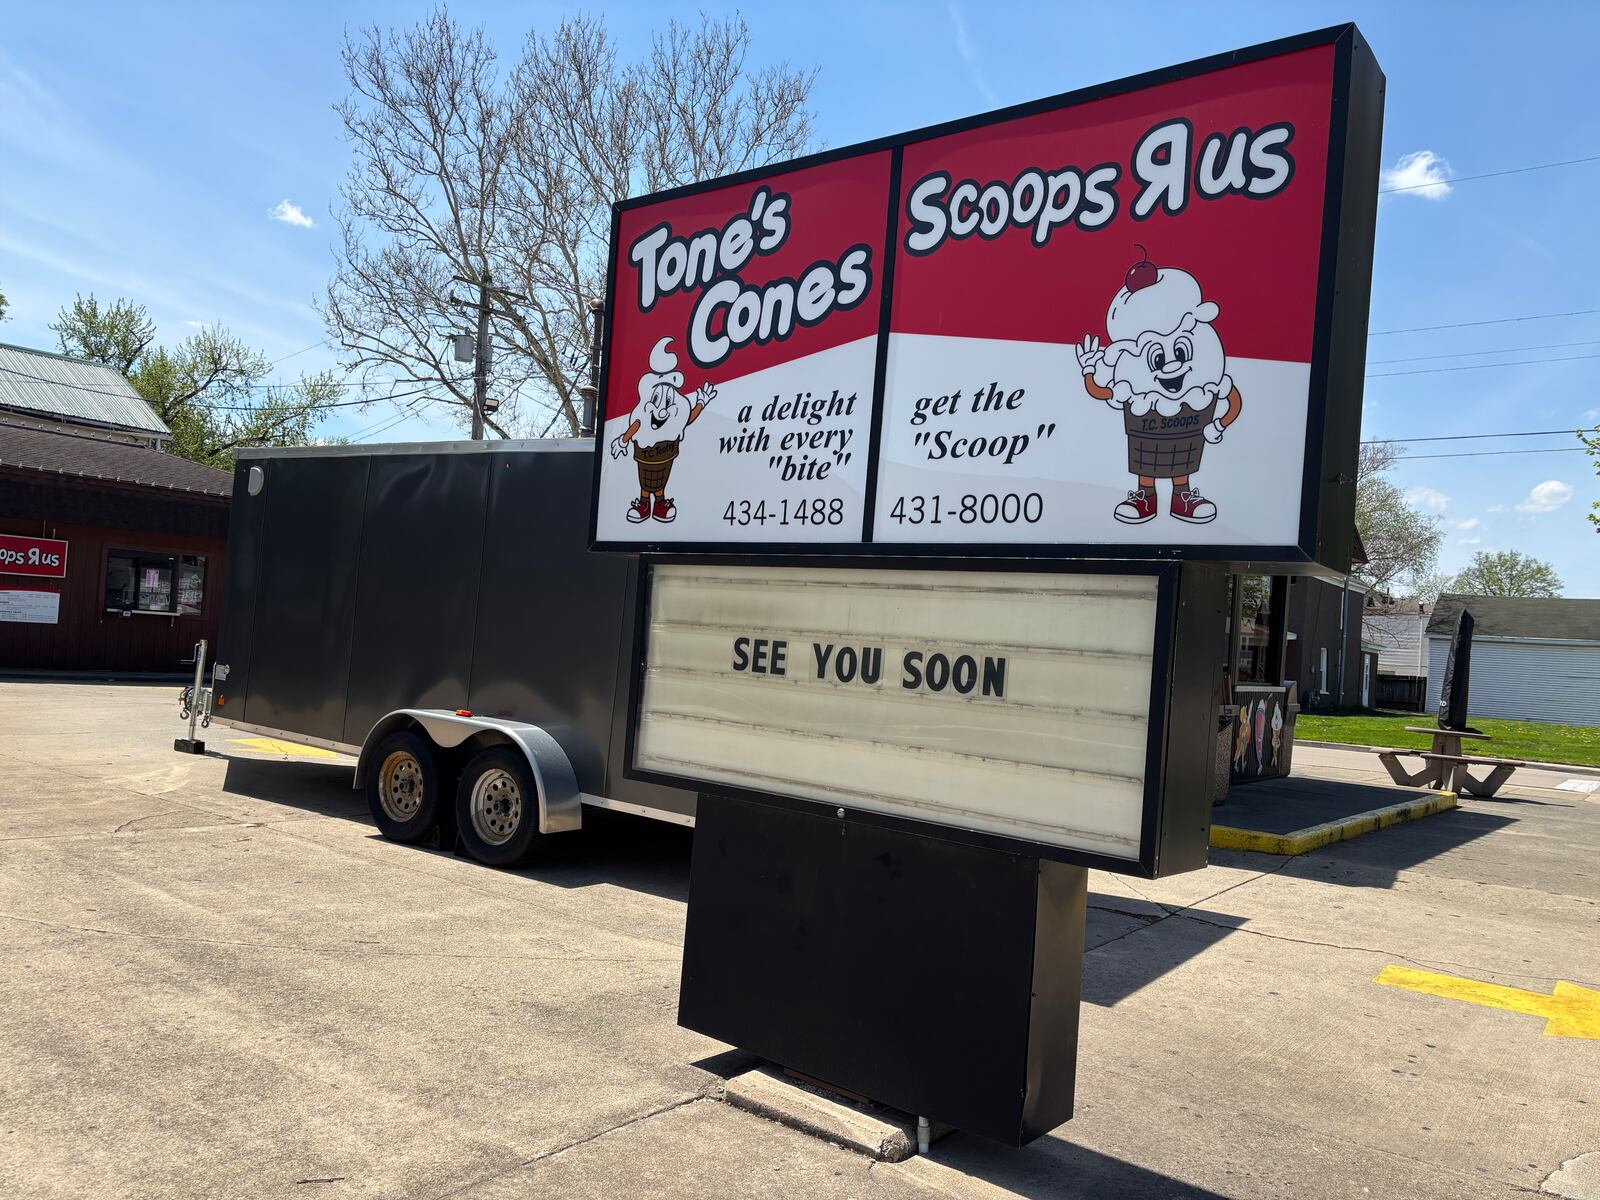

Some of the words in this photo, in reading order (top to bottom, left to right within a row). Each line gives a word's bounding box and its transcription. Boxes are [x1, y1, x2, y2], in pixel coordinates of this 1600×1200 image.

[906, 164, 1119, 253] Scoops
[1198, 125, 1293, 197] us
[630, 188, 790, 311] Tone's
[689, 246, 870, 366] Cones
[737, 403, 753, 424] a
[761, 389, 858, 426] delight
[910, 388, 962, 426] get
[971, 381, 1025, 414] the
[719, 426, 771, 455] with
[780, 428, 854, 456] every
[1141, 418, 1158, 431] T.C.
[1160, 414, 1200, 429] Scoops
[914, 422, 1057, 465] "Scoop"
[768, 452, 852, 482] "bite"
[723, 498, 844, 526] 434-1488
[890, 492, 1044, 525] 431-8000
[41, 552, 60, 567] us
[732, 637, 788, 676] SEE
[813, 642, 883, 685] YOU
[902, 651, 1006, 698] SOON
